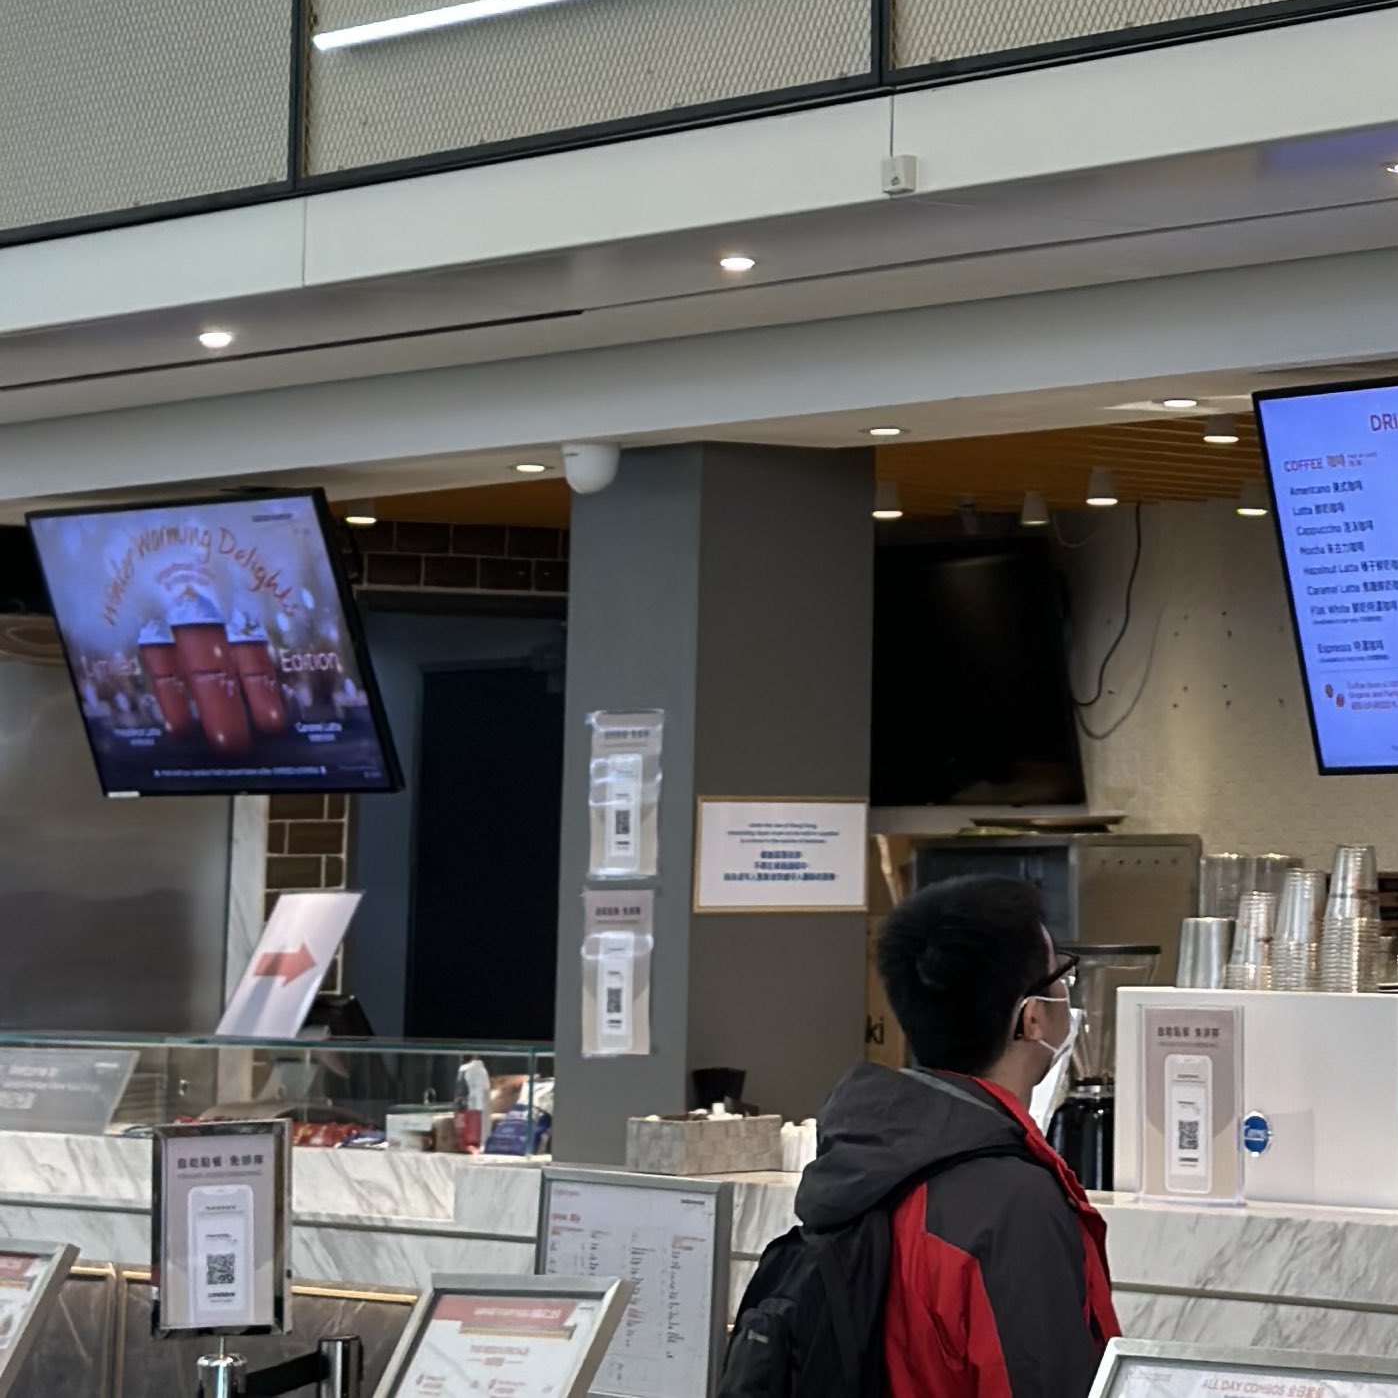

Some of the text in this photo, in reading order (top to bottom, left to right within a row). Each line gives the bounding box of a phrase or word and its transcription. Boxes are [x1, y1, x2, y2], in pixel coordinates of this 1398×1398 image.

[1283, 457, 1323, 473] COFFEE
[1290, 484, 1332, 496] Americano
[1292, 506, 1313, 516] Latte
[1296, 524, 1342, 536] Cappuccino
[1300, 545, 1325, 555] Mocha
[1306, 584, 1338, 596] Caramel
[1328, 603, 1350, 613] White
[1317, 643, 1352, 655] Espresso
[1202, 1377, 1219, 1391] ALL
[1220, 1379, 1242, 1392] DAY
[1243, 1382, 1285, 1397] COMBOS
